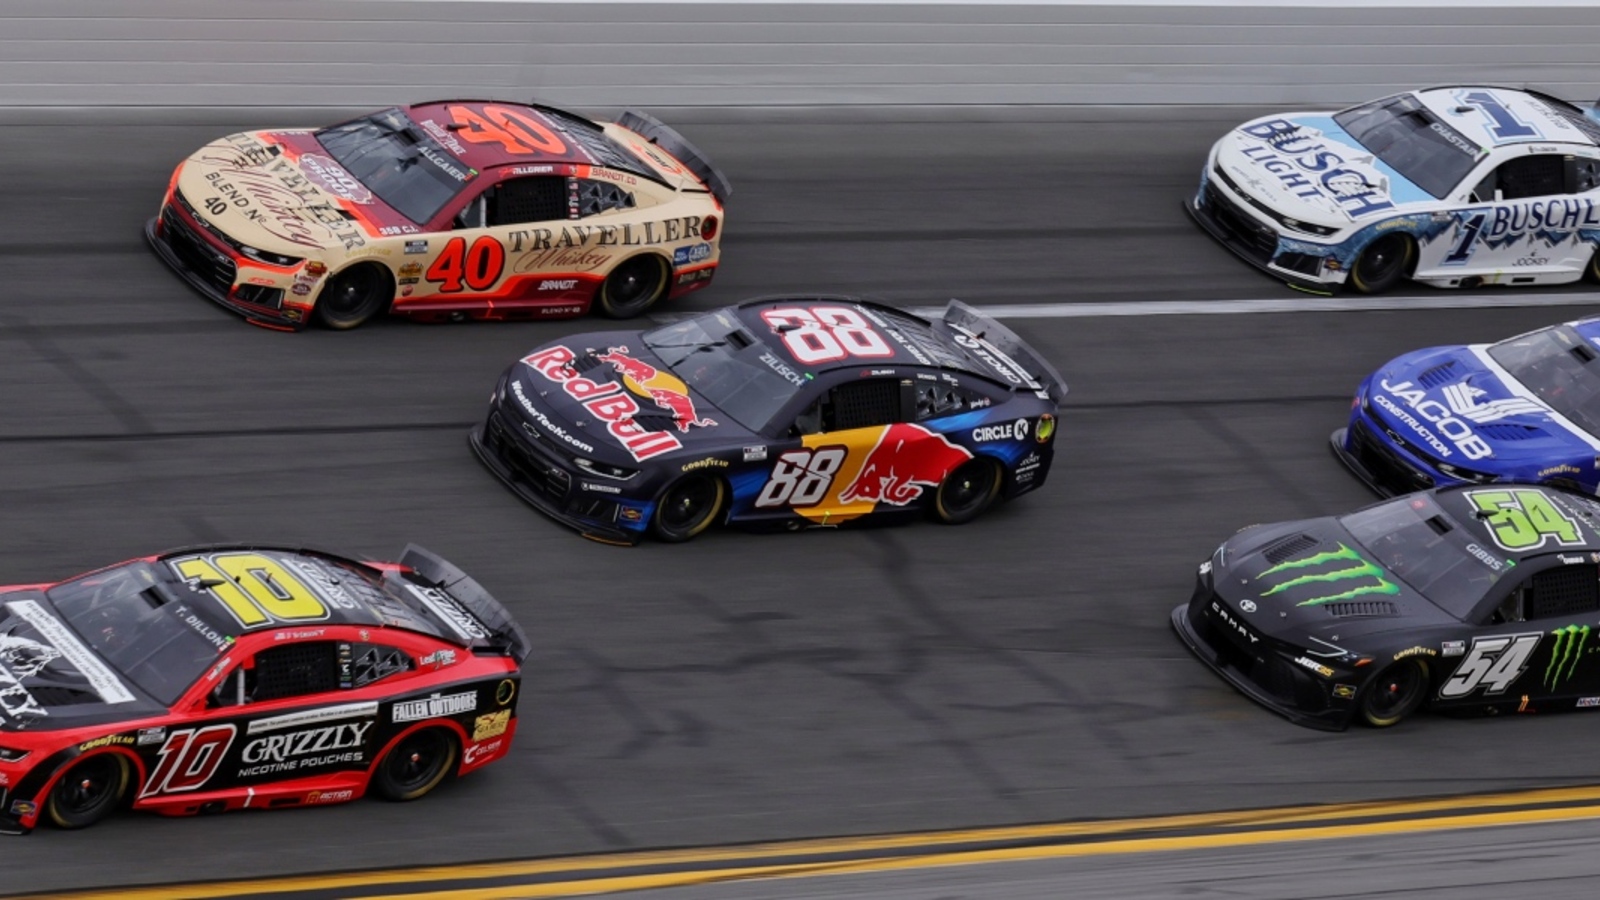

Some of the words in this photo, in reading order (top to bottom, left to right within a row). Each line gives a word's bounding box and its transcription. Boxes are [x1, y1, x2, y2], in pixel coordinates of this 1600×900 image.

[449, 105, 567, 156] 40
[1430, 122, 1479, 157] CHASTAIN
[1456, 90, 1543, 142] 1
[417, 146, 465, 182] ALLGAIER
[1240, 146, 1326, 199] LIGHT
[1241, 118, 1396, 220] BUSCH
[204, 196, 229, 216] 40
[205, 171, 250, 209] BLEND
[508, 215, 702, 253] TRAVELLER
[1441, 209, 1489, 265] 1
[1489, 198, 1581, 241] BUSCH
[425, 235, 505, 293] 40
[513, 246, 613, 274] Whiskey
[759, 305, 896, 366] 88
[758, 352, 805, 388] ZILISCH
[511, 379, 594, 453] WeatherTech.com
[519, 345, 622, 402] Red
[582, 392, 683, 463] Bull
[1373, 394, 1453, 458] CONSTRUCTION
[1381, 378, 1495, 461] JACOB
[972, 424, 1012, 442] CIRCLE
[1014, 418, 1029, 441] K
[755, 445, 850, 508] 88
[1462, 489, 1588, 552] 54
[1465, 542, 1503, 571] GIBBS
[170, 551, 331, 629] 10
[186, 615, 224, 648] DILLON
[1439, 631, 1545, 699] 54
[391, 702, 428, 724] FALLEN
[429, 691, 478, 719] OUTDOORS
[139, 723, 237, 799] 10
[237, 758, 298, 778] NICOTINE
[299, 751, 364, 768] POUCHES
[242, 720, 375, 763] GRIZZLY
